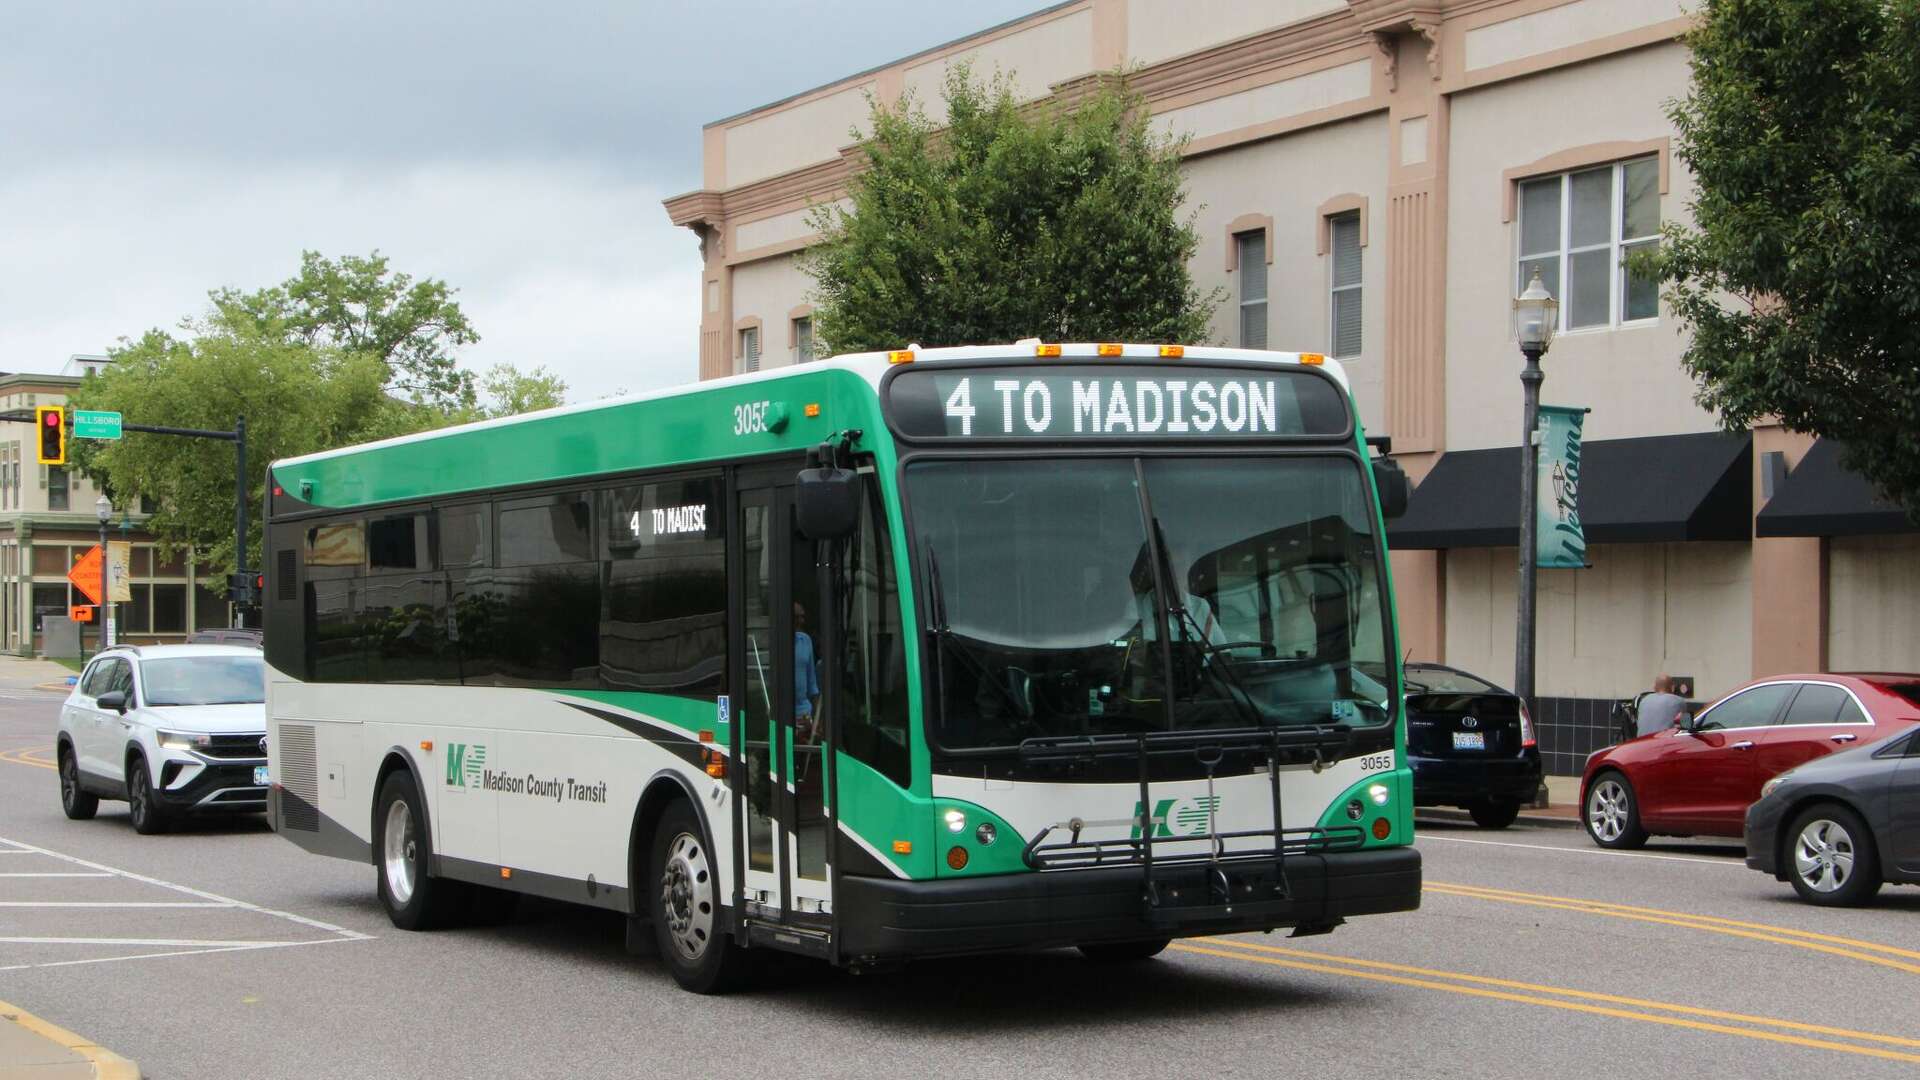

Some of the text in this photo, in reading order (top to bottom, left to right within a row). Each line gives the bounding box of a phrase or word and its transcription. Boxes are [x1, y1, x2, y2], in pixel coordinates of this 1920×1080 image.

[75, 415, 120, 425] HILLSBORO
[945, 378, 1277, 435] 4 TO MADISON
[630, 504, 706, 536] 4 TO MADISO
[1360, 756, 1391, 770] 3055
[483, 769, 607, 803] Madison County Transit
